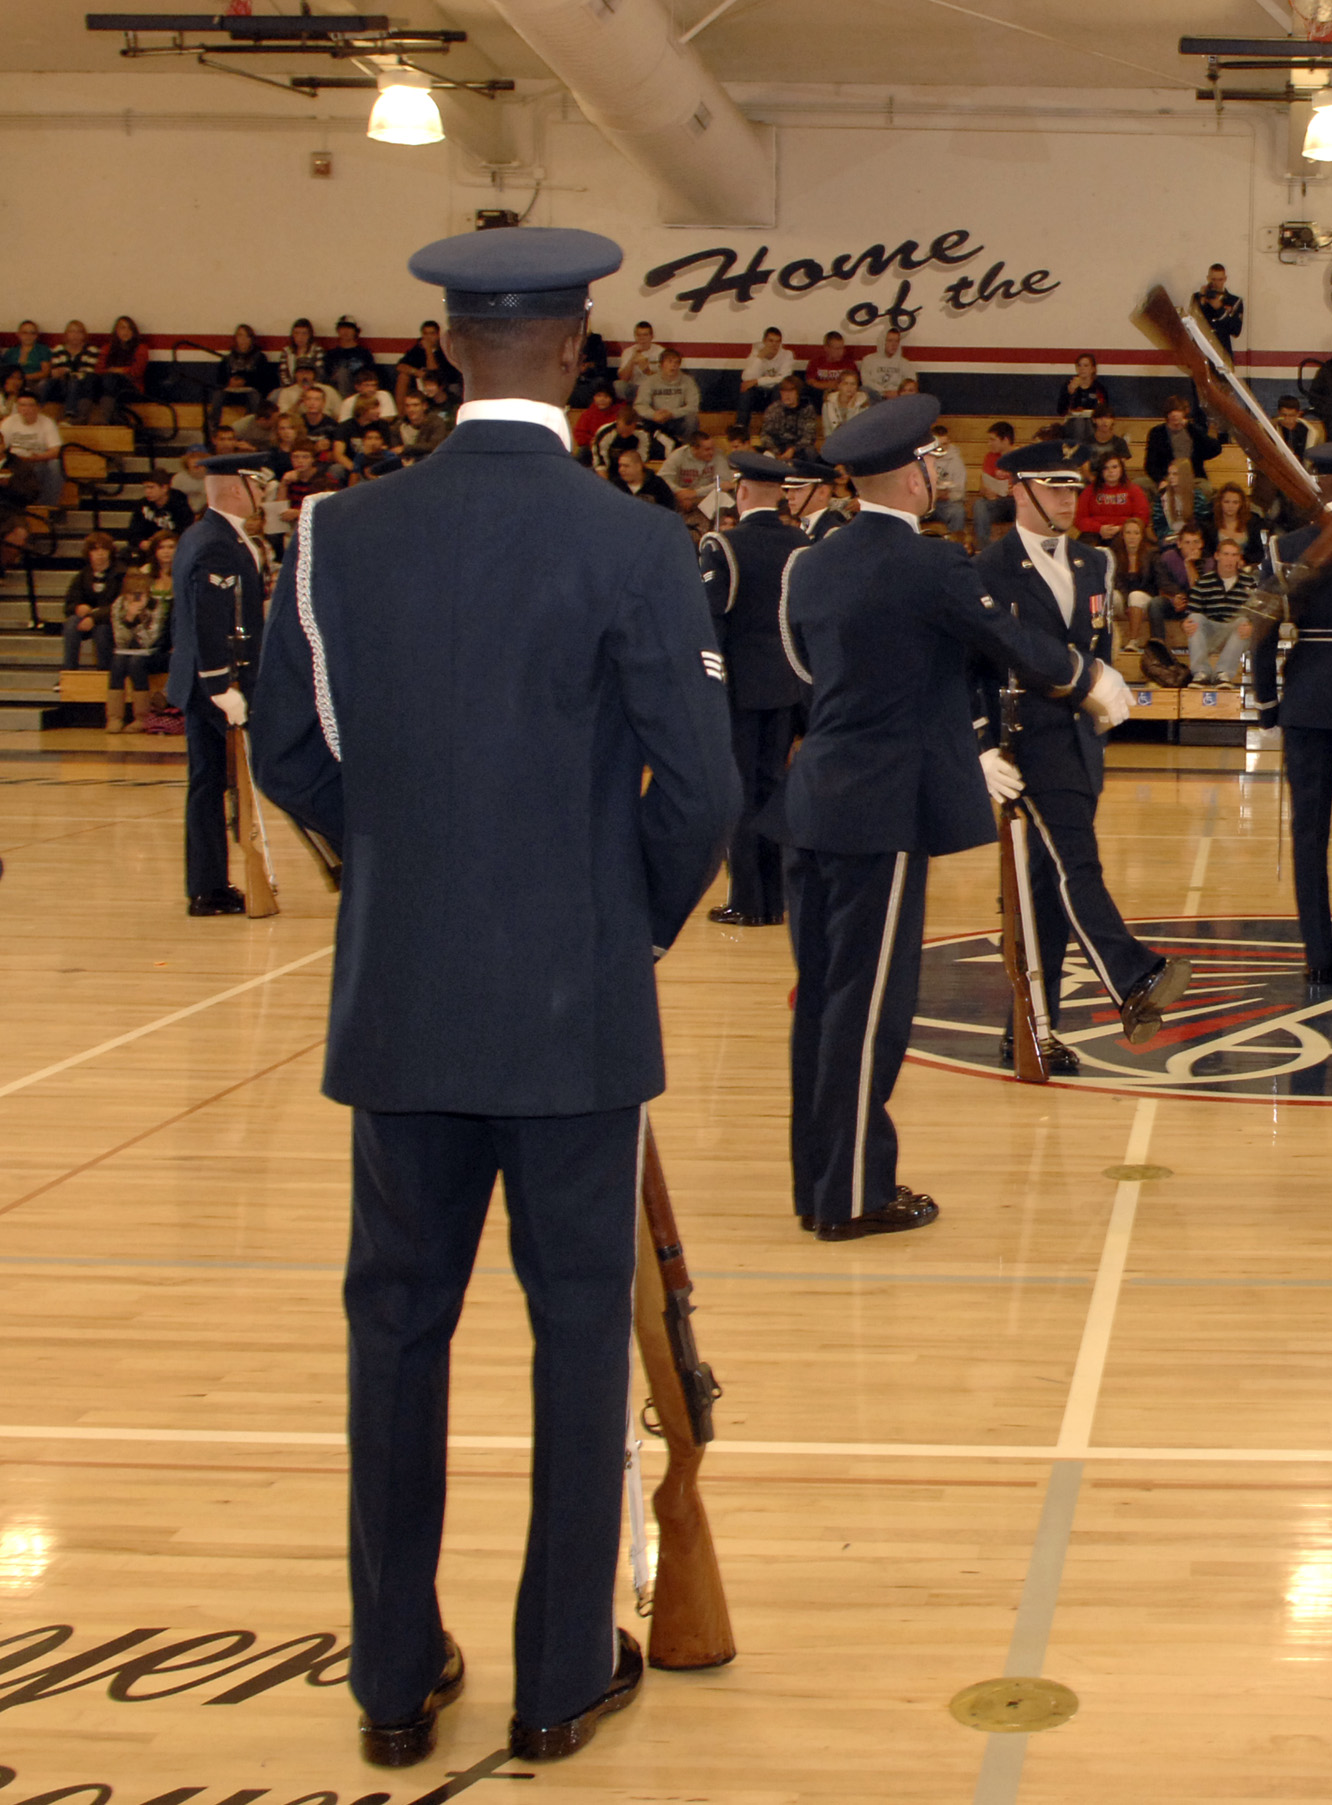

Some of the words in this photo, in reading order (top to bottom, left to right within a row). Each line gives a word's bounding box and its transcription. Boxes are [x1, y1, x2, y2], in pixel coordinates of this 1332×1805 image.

[644, 228, 985, 314] Home
[846, 279, 923, 334] of
[945, 260, 1062, 310] the
